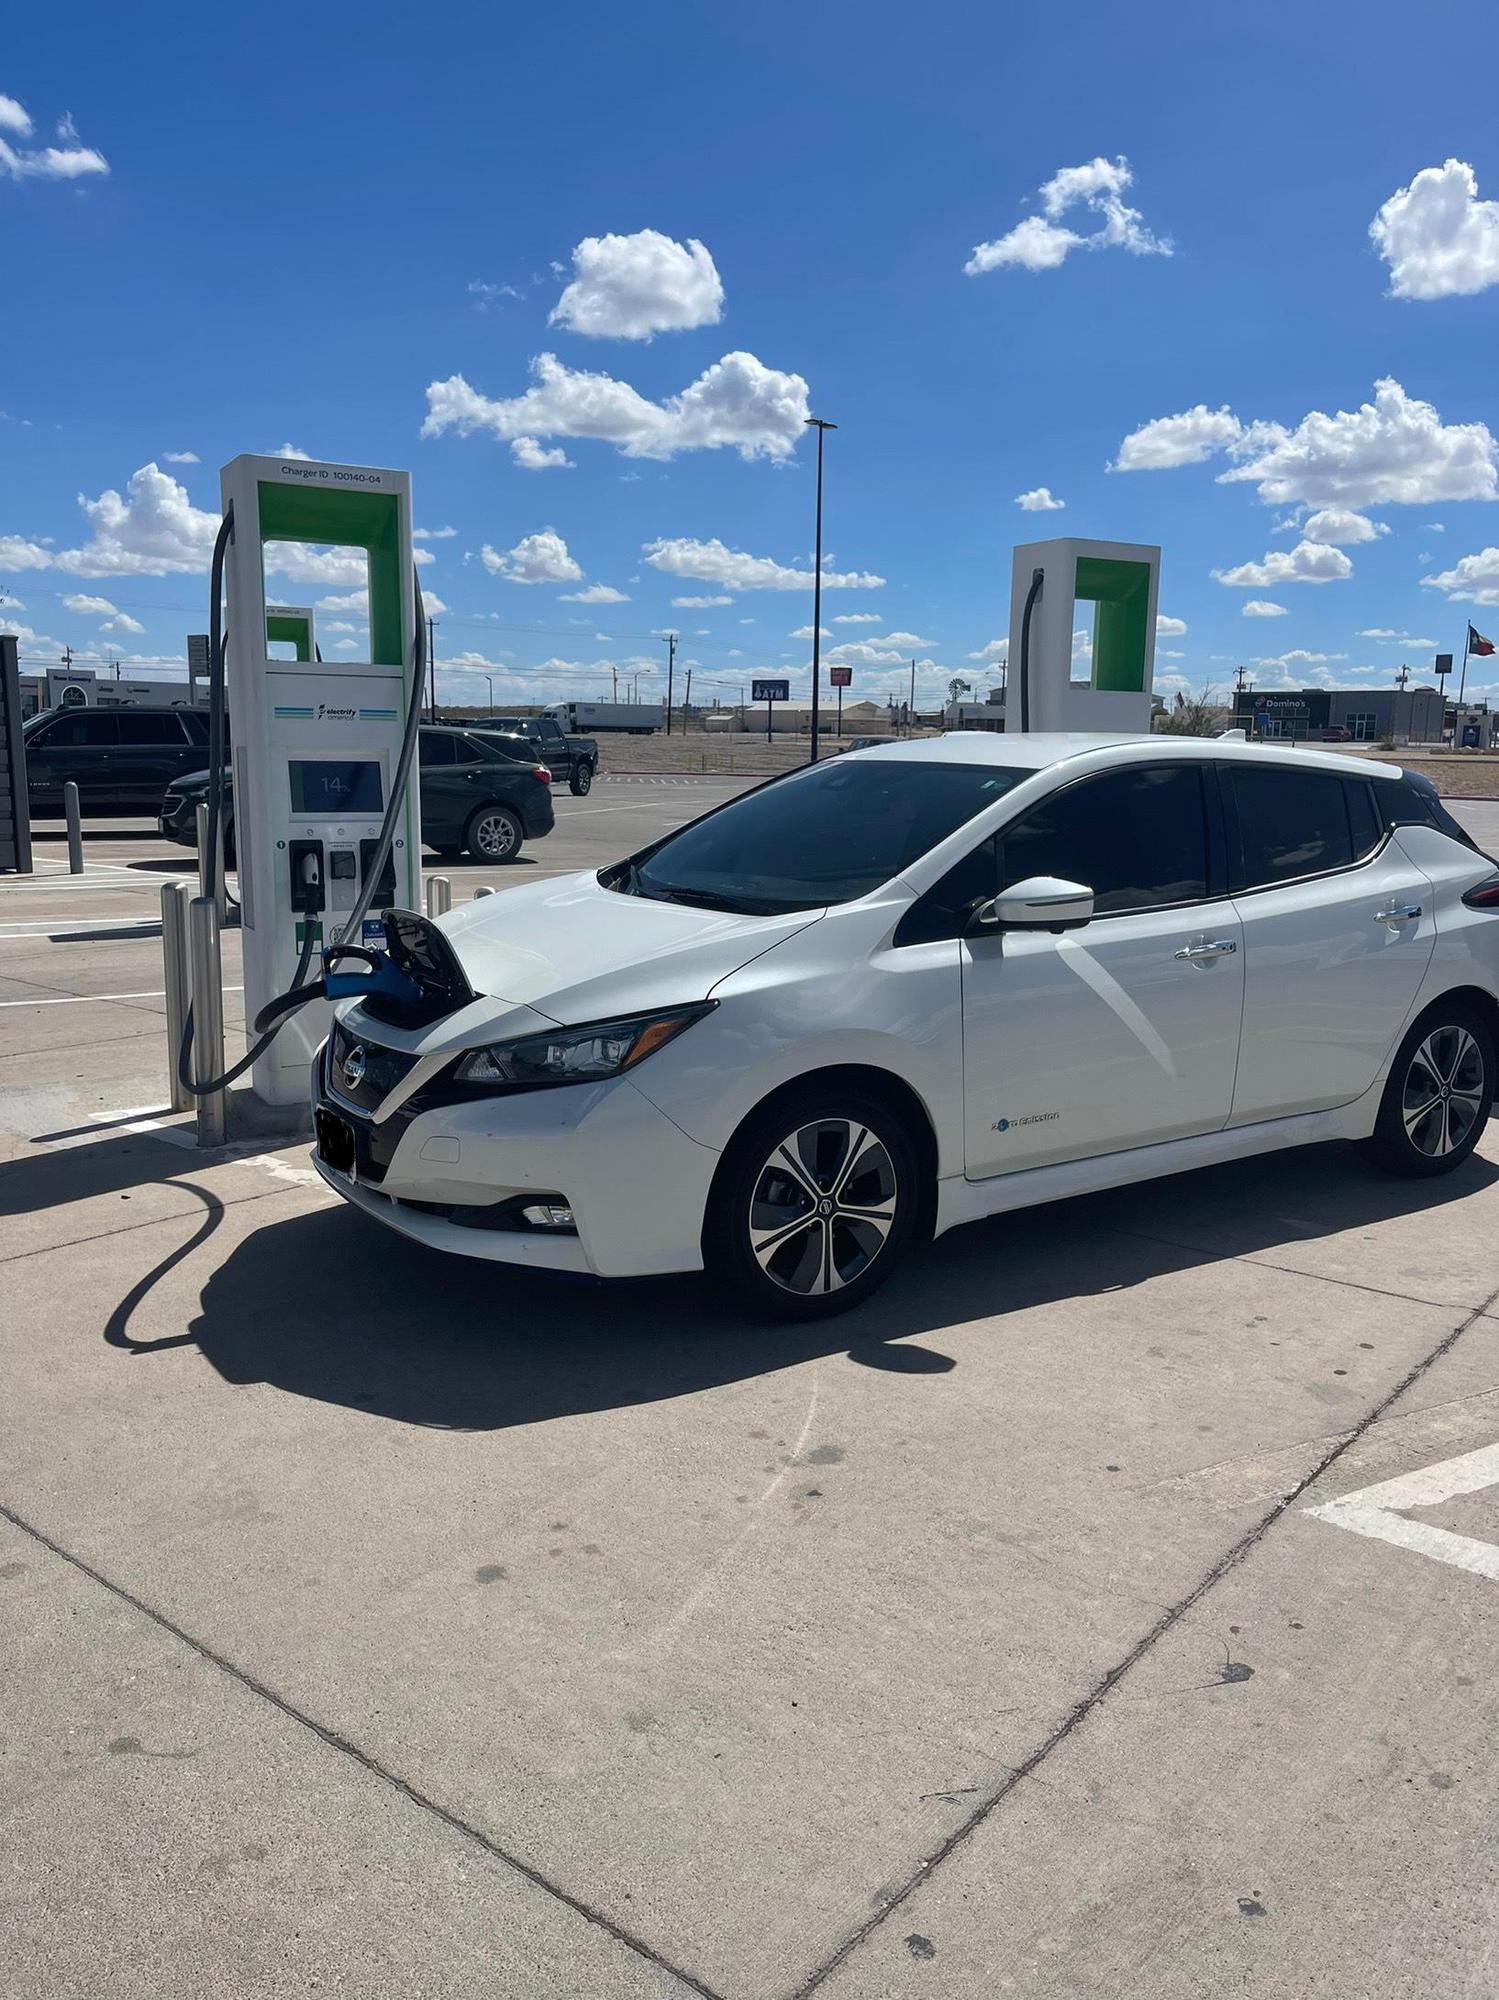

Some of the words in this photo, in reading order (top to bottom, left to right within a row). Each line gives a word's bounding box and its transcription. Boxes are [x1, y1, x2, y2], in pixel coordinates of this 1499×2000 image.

[281, 466, 317, 479] Charger
[319, 470, 329, 479] ID
[333, 471, 381, 484] 100140-04
[762, 688, 784, 700] ATM
[1266, 699, 1306, 708] Domino's
[327, 709, 356, 717] electrify
